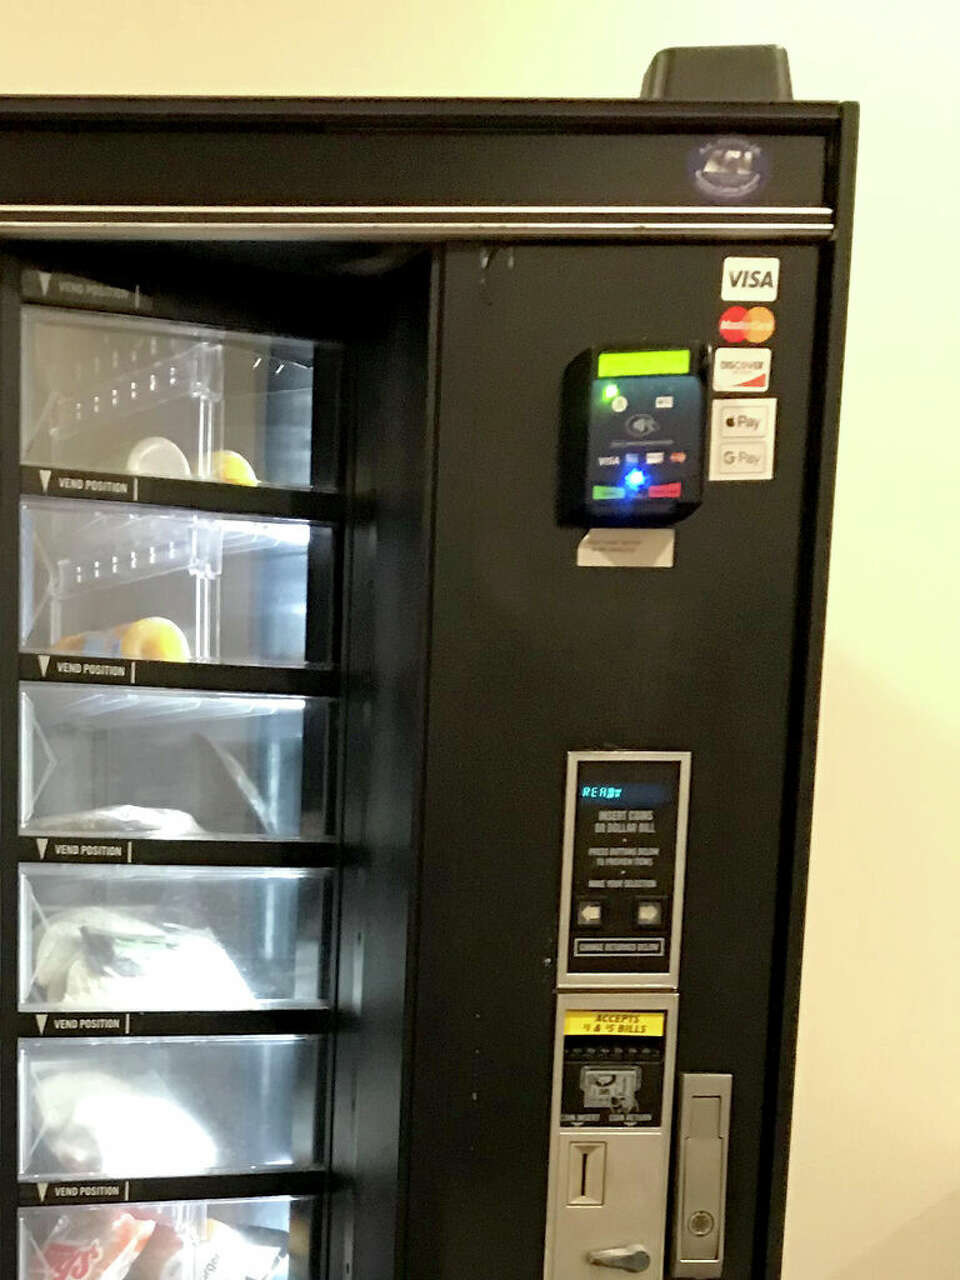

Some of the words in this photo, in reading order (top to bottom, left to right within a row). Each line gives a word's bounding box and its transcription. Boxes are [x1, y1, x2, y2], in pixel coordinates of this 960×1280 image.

[728, 270, 774, 288] VISA
[737, 415, 761, 431] Pay
[738, 451, 761, 466] Pay
[59, 478, 84, 489] VEND
[85, 479, 127, 493] POSITION
[57, 662, 82, 674] VEND
[83, 663, 125, 676] POSITION
[55, 844, 79, 855] VEND
[81, 845, 122, 856] POSITION
[54, 1019, 78, 1029] VEND
[79, 1019, 120, 1029] POSITION
[595, 1014, 640, 1023] ACCEPTS
[617, 1024, 647, 1033] BILLS
[54, 1186, 78, 1196] VEND
[80, 1186, 119, 1196] POSITION
